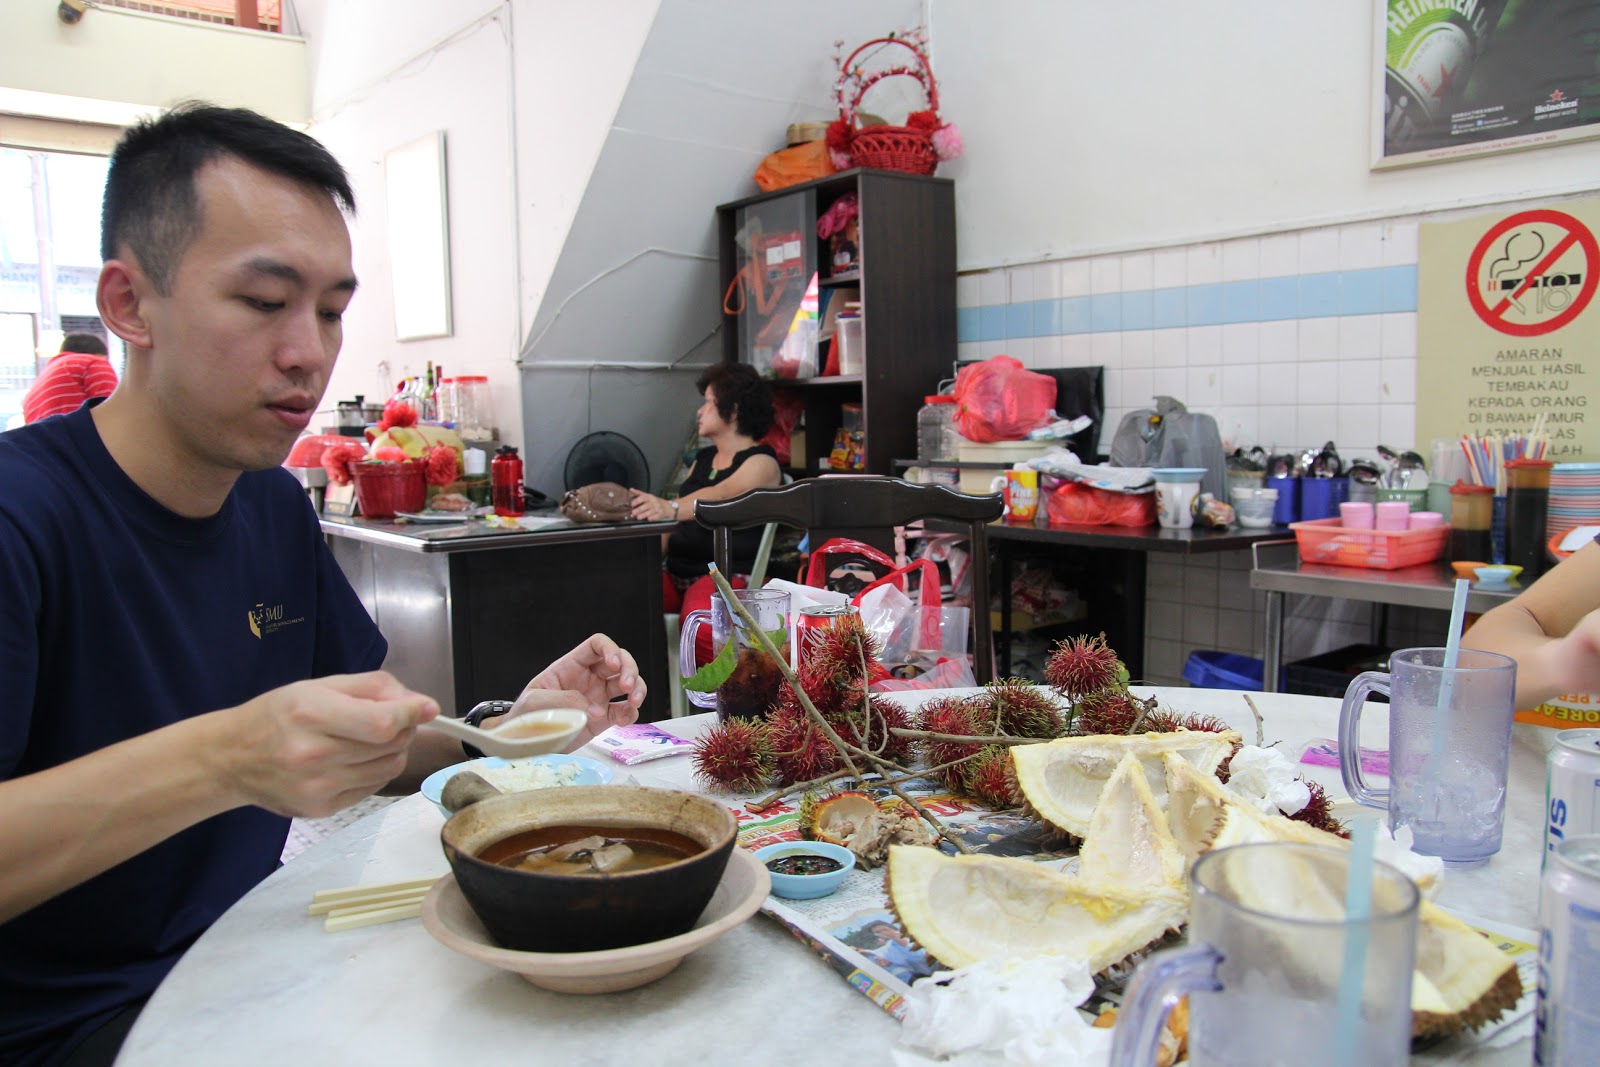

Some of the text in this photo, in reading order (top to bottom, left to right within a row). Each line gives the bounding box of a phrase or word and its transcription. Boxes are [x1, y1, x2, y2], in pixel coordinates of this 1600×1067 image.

[1534, 100, 1578, 114] Heineken
[1496, 348, 1563, 361] AMARAN
[1471, 363, 1586, 377] MENJUAL HASIL
[1487, 380, 1569, 392] TEMBAKAU
[1468, 396, 1587, 408] KEPADA ORANG
[1469, 413, 1482, 424] DI
[1486, 412, 1536, 424] BAWAH
[1533, 704, 1600, 724] OREA
